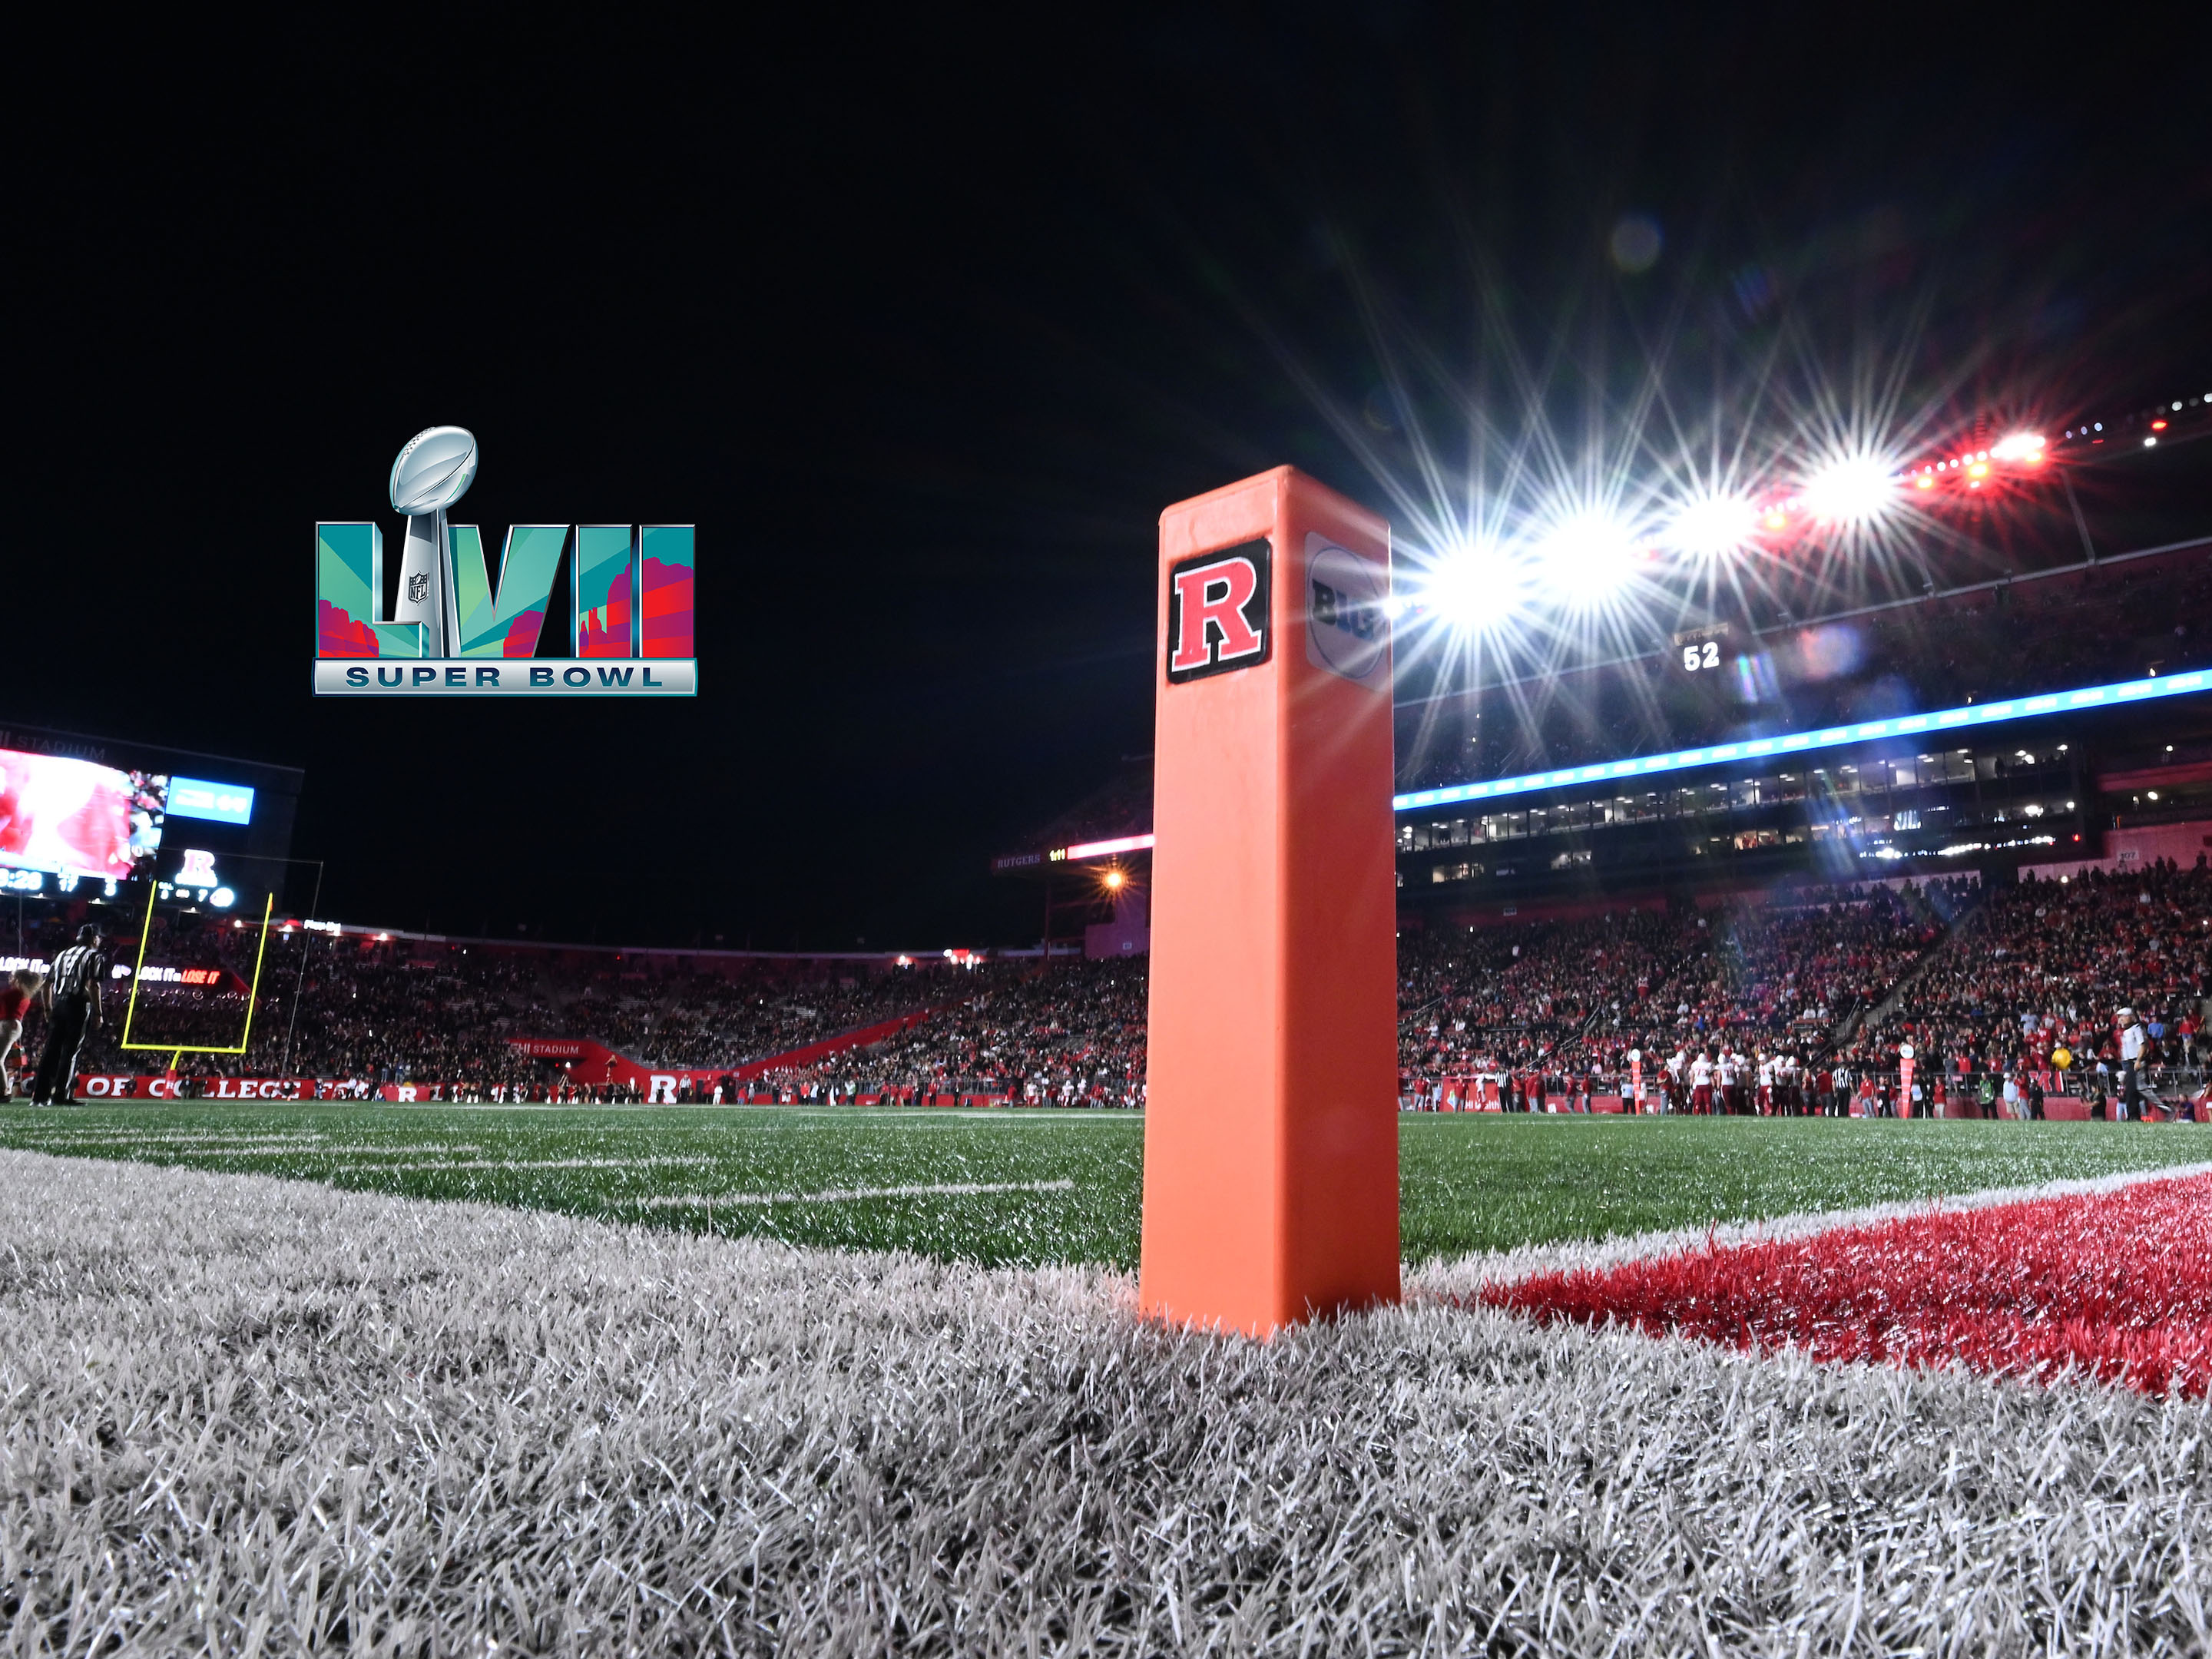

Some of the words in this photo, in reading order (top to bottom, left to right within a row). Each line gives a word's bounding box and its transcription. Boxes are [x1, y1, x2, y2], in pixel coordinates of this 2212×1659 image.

[1171, 556, 1263, 673] R
[1684, 641, 1720, 671] 52
[17, 735, 105, 760] STADIUM
[997, 853, 1041, 869] RUTGERS
[0, 956, 29, 972] LOCK
[30, 959, 43, 973] IT
[181, 969, 207, 983] LOSE
[207, 971, 220, 985] IT
[533, 1045, 579, 1055] STADIUM
[86, 1077, 128, 1097] OF
[398, 1087, 417, 1103] R
[648, 1075, 677, 1104] R
